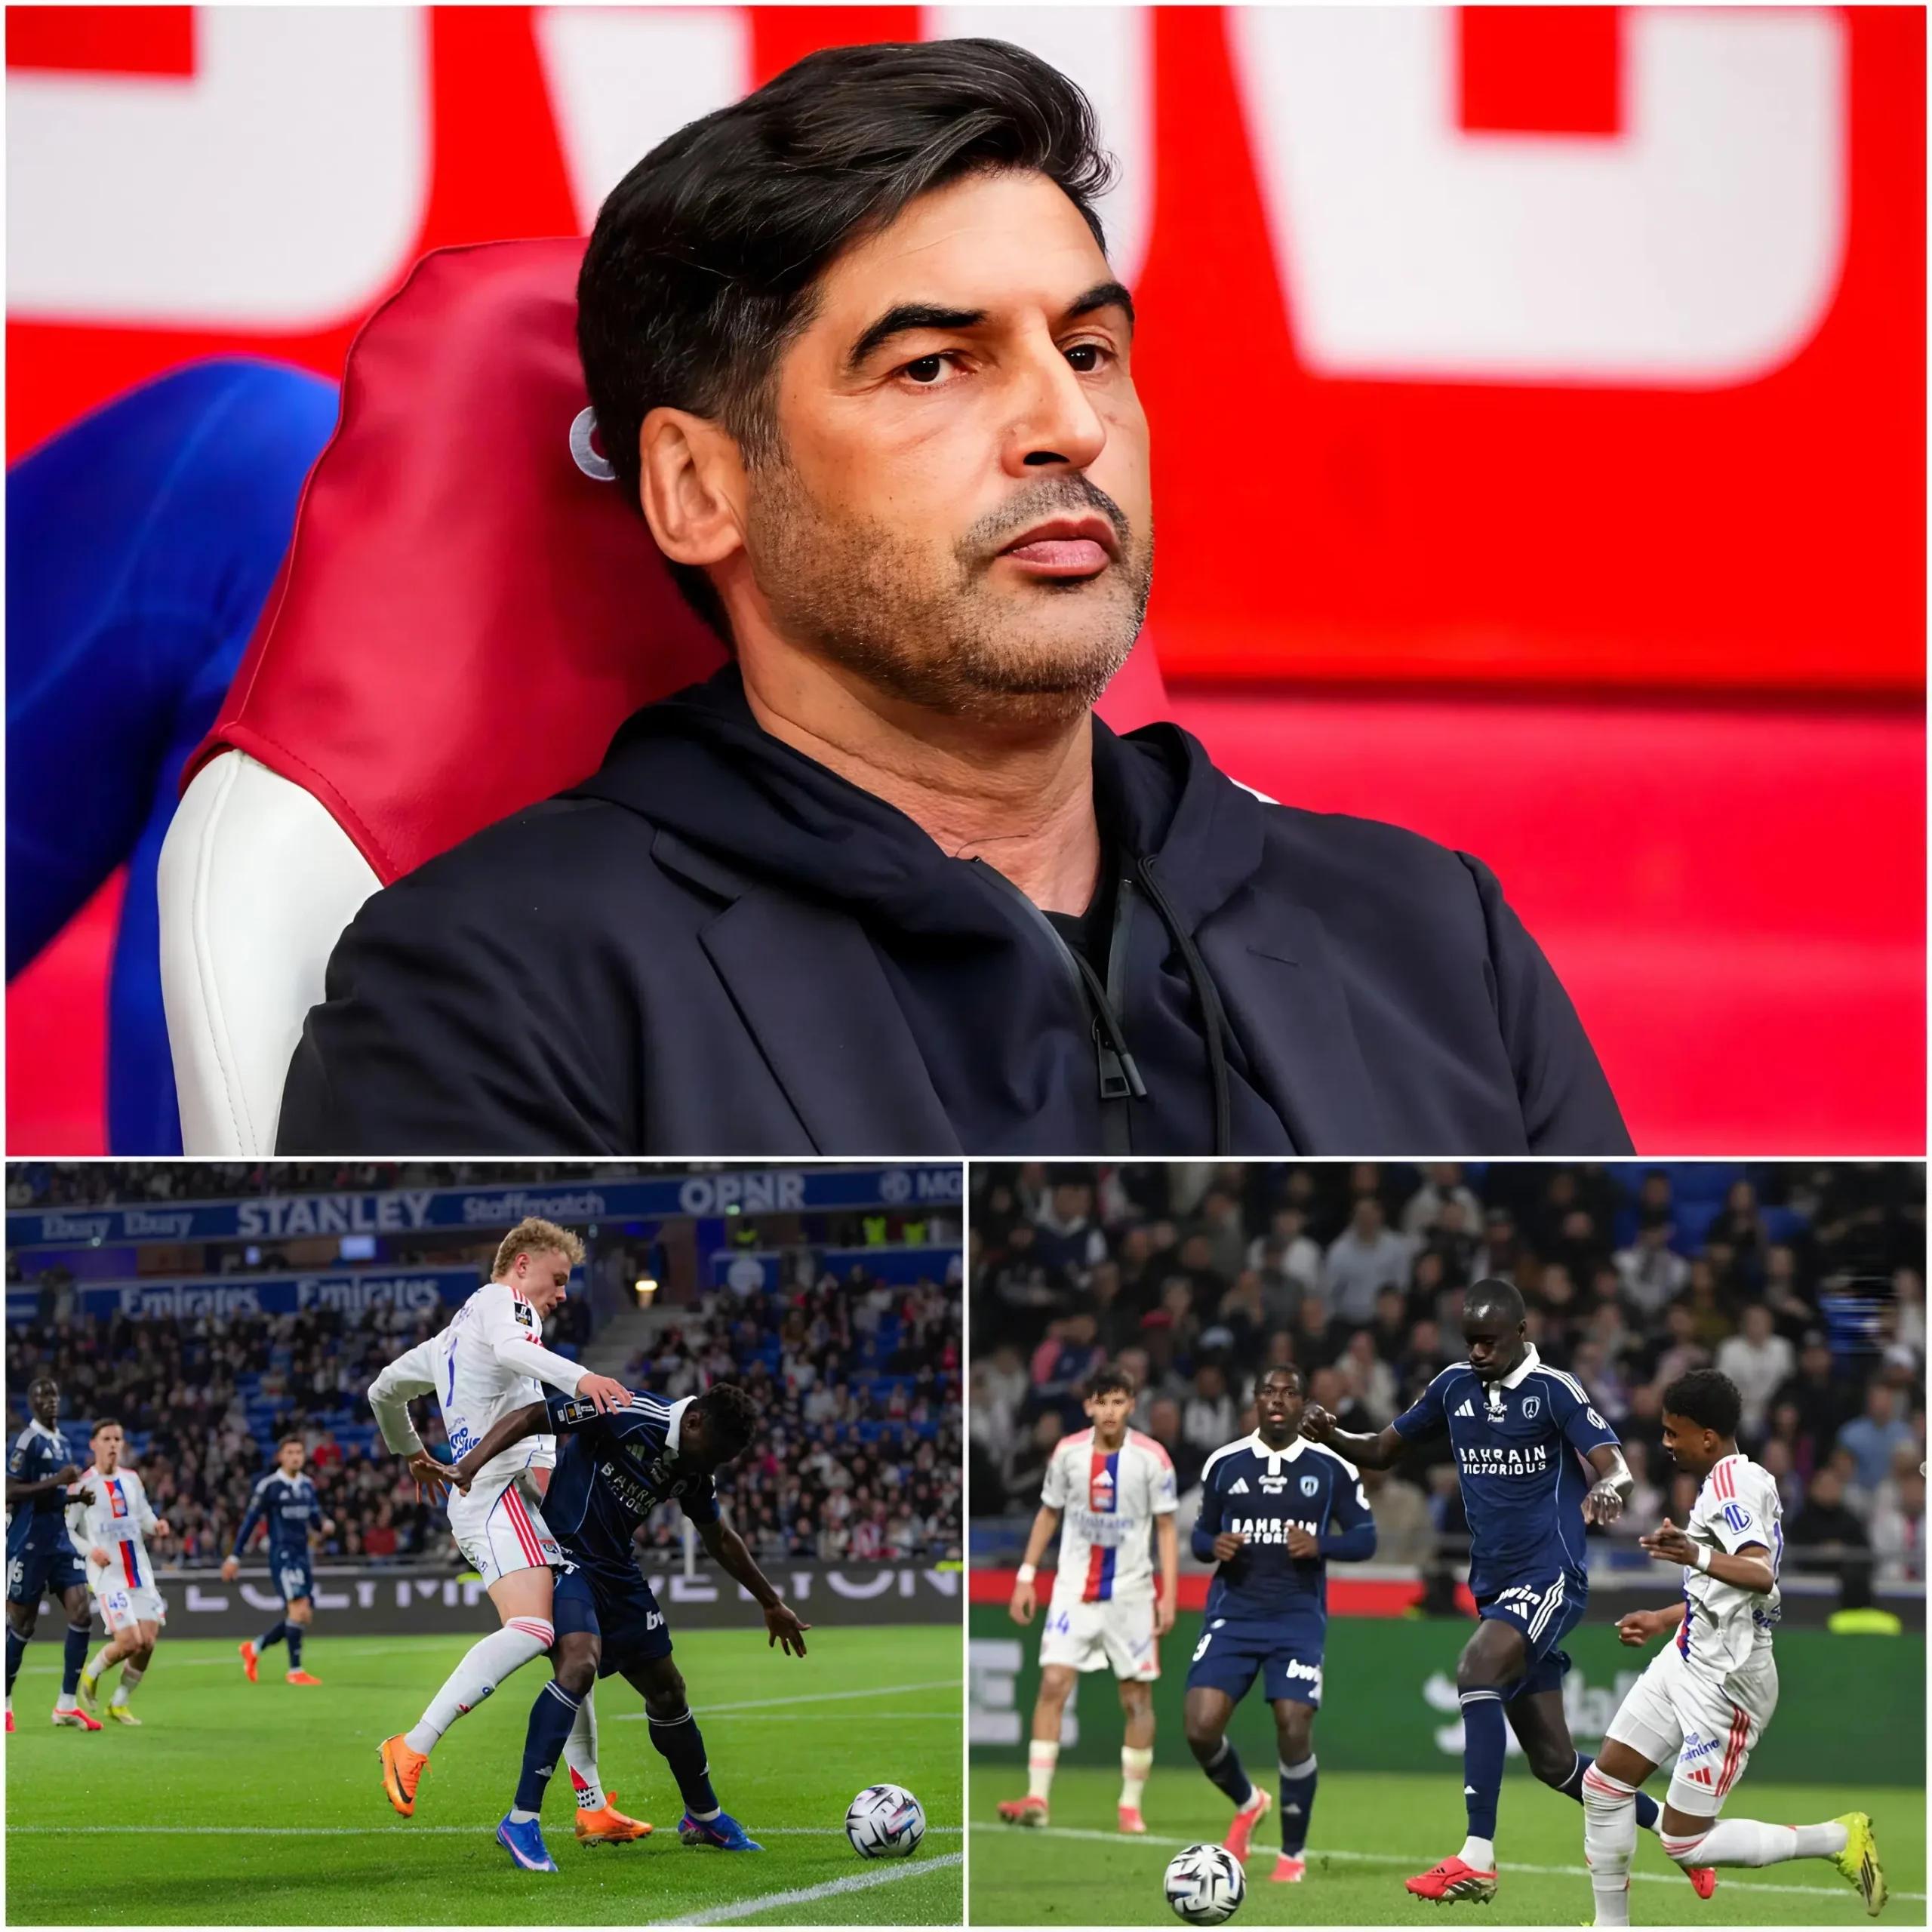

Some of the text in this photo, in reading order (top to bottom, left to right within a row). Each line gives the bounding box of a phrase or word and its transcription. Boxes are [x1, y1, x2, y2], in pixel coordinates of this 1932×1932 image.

[463, 1189, 605, 1223] Staffmatch
[681, 1173, 805, 1214] OPNR
[237, 1192, 433, 1236] STANLEY
[120, 1285, 258, 1318] Emirates
[297, 1278, 439, 1309] Emirates
[1192, 1632, 1212, 1662] 9
